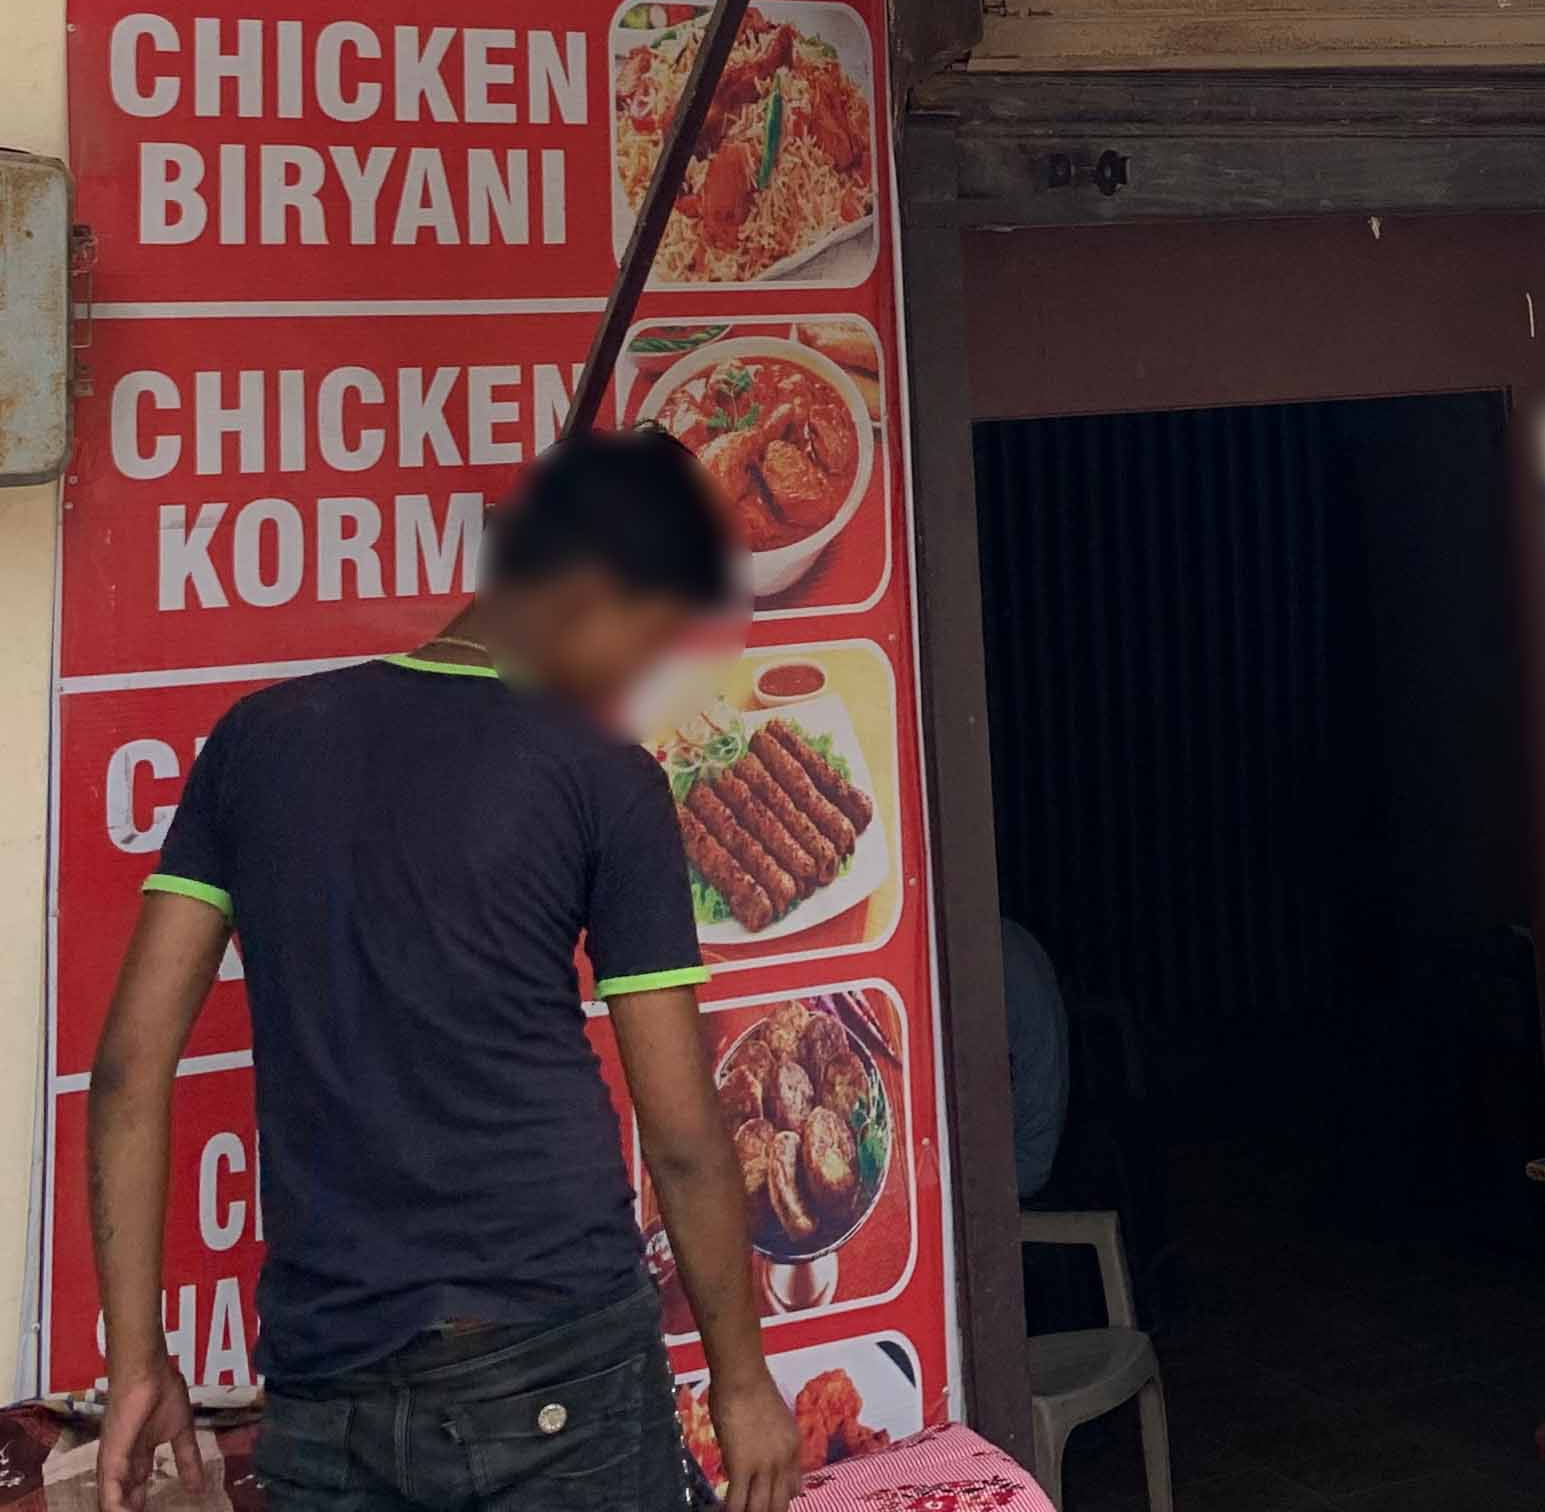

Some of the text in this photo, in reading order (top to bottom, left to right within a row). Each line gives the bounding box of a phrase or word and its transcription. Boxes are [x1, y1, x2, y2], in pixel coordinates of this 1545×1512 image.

[109, 13, 589, 126] CHICKEN
[139, 143, 567, 246] BIRYANI
[110, 364, 588, 481] CHICKEN
[157, 492, 484, 611] KORM
